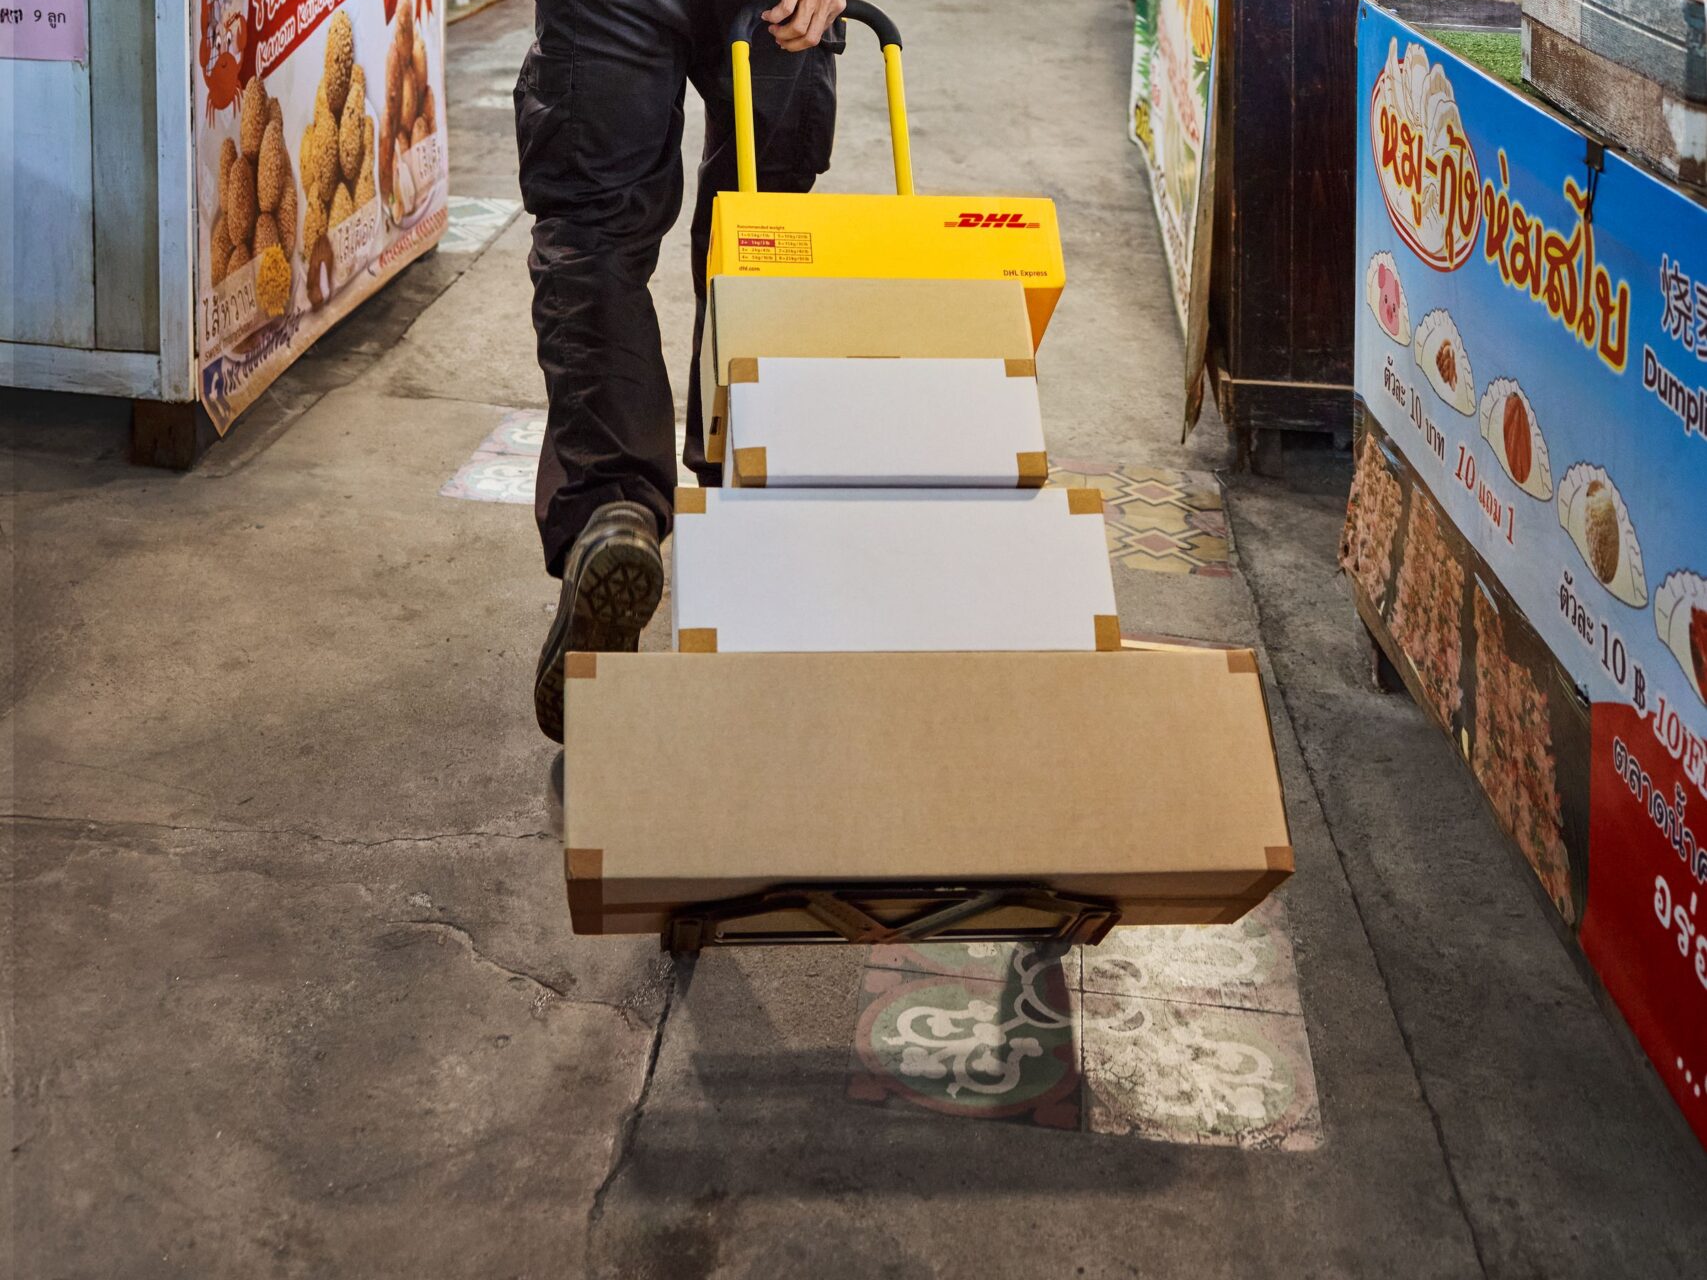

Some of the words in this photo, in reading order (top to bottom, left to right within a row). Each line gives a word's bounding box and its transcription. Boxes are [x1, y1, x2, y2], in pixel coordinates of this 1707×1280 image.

[34, 10, 42, 22] 9
[48, 12, 66, 28] ลูก
[957, 213, 1027, 228] DHL
[1020, 269, 1048, 278] Express
[203, 284, 257, 342] ไส้หวาน
[1384, 355, 1406, 407] ตัวละ
[1410, 387, 1422, 430] 10
[1425, 418, 1445, 461] บาท
[1455, 446, 1476, 490] 10
[1478, 480, 1502, 528] แถม
[1506, 506, 1514, 545] 1
[1559, 571, 1594, 646] ตัวละ
[1601, 622, 1627, 685] 10
[1656, 697, 1680, 751] 10
